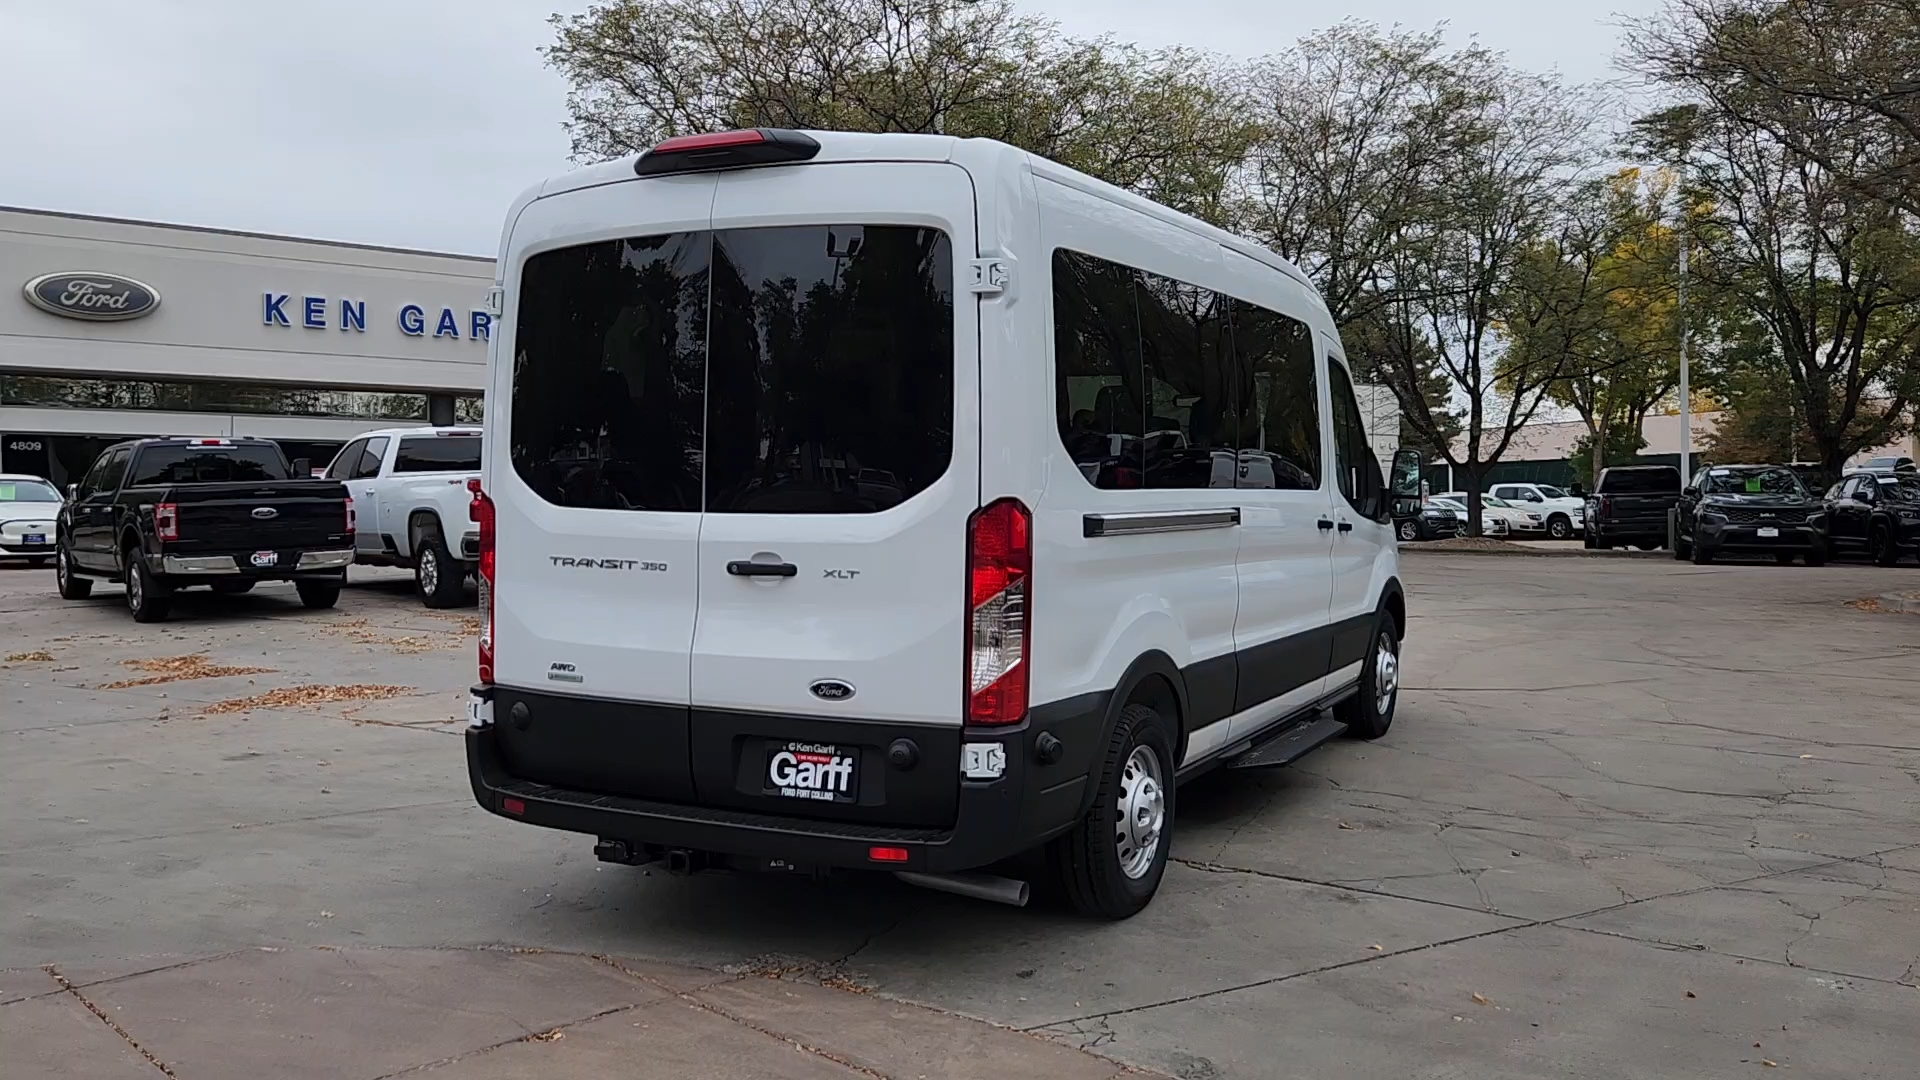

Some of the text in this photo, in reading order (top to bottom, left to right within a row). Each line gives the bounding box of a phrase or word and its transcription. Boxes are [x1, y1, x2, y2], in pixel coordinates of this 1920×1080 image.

[60, 280, 130, 309] Ford
[263, 292, 367, 332] KEN
[10, 441, 42, 451] 4809
[549, 556, 667, 571] TRANSIT 350
[823, 569, 860, 579] XLT
[550, 662, 576, 672] AWD
[818, 685, 843, 697] Ford
[796, 742, 835, 755] Ken Garff
[770, 752, 853, 791] Garff
[781, 787, 796, 797] FORD
